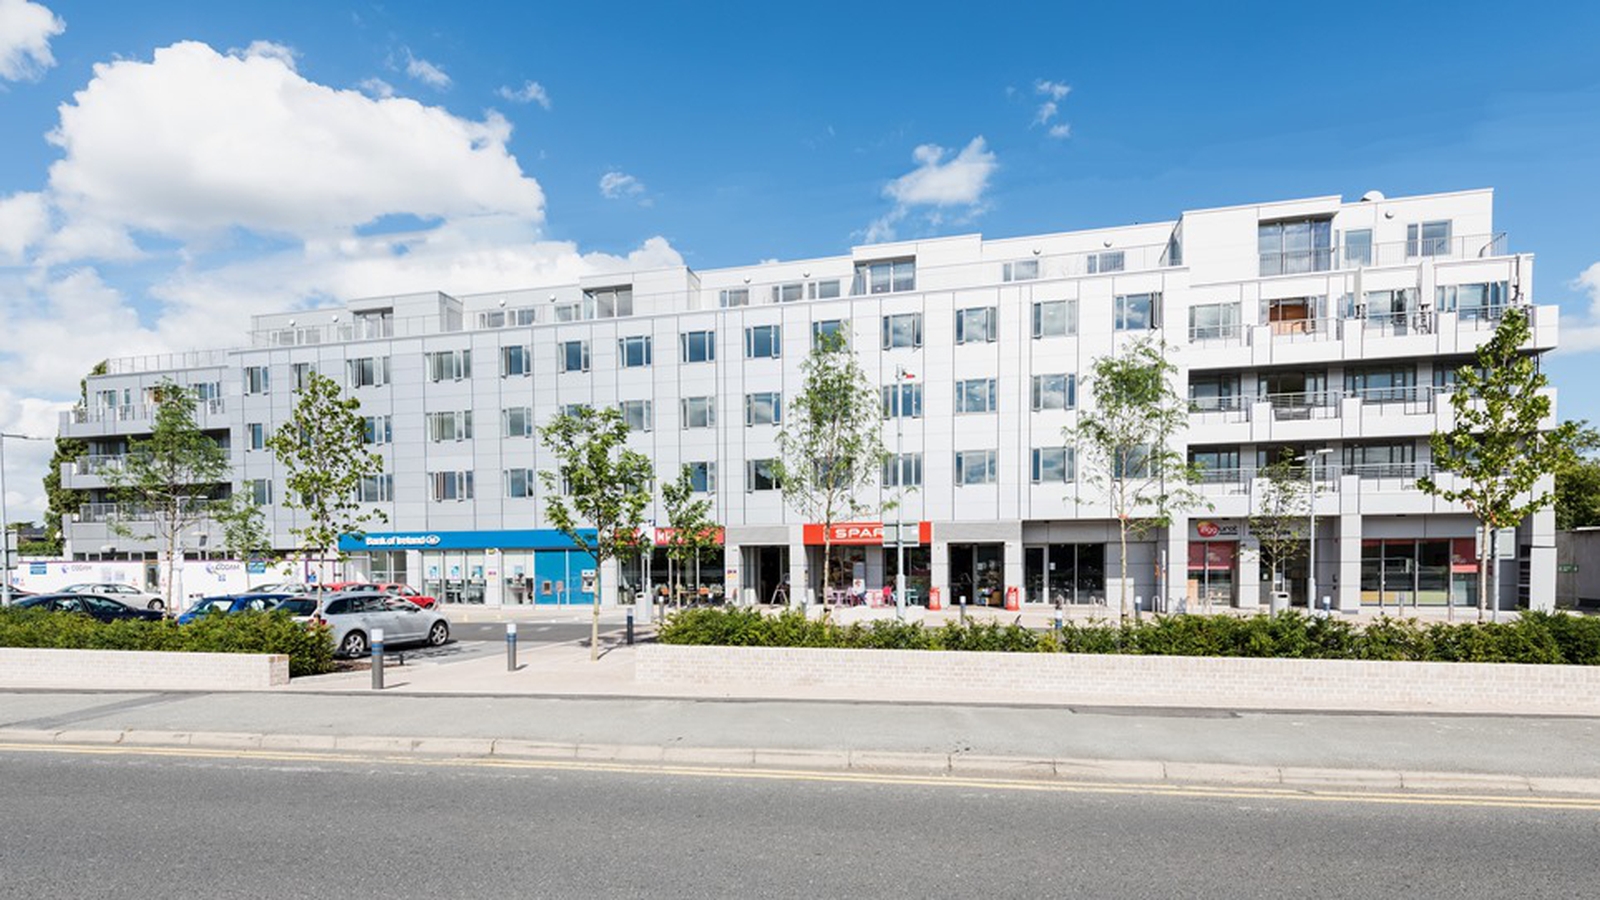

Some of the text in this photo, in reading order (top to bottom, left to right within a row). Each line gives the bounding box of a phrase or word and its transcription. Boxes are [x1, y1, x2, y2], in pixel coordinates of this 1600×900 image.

[835, 527, 883, 539] SPAR
[365, 536, 426, 545] Bank of Ireland
